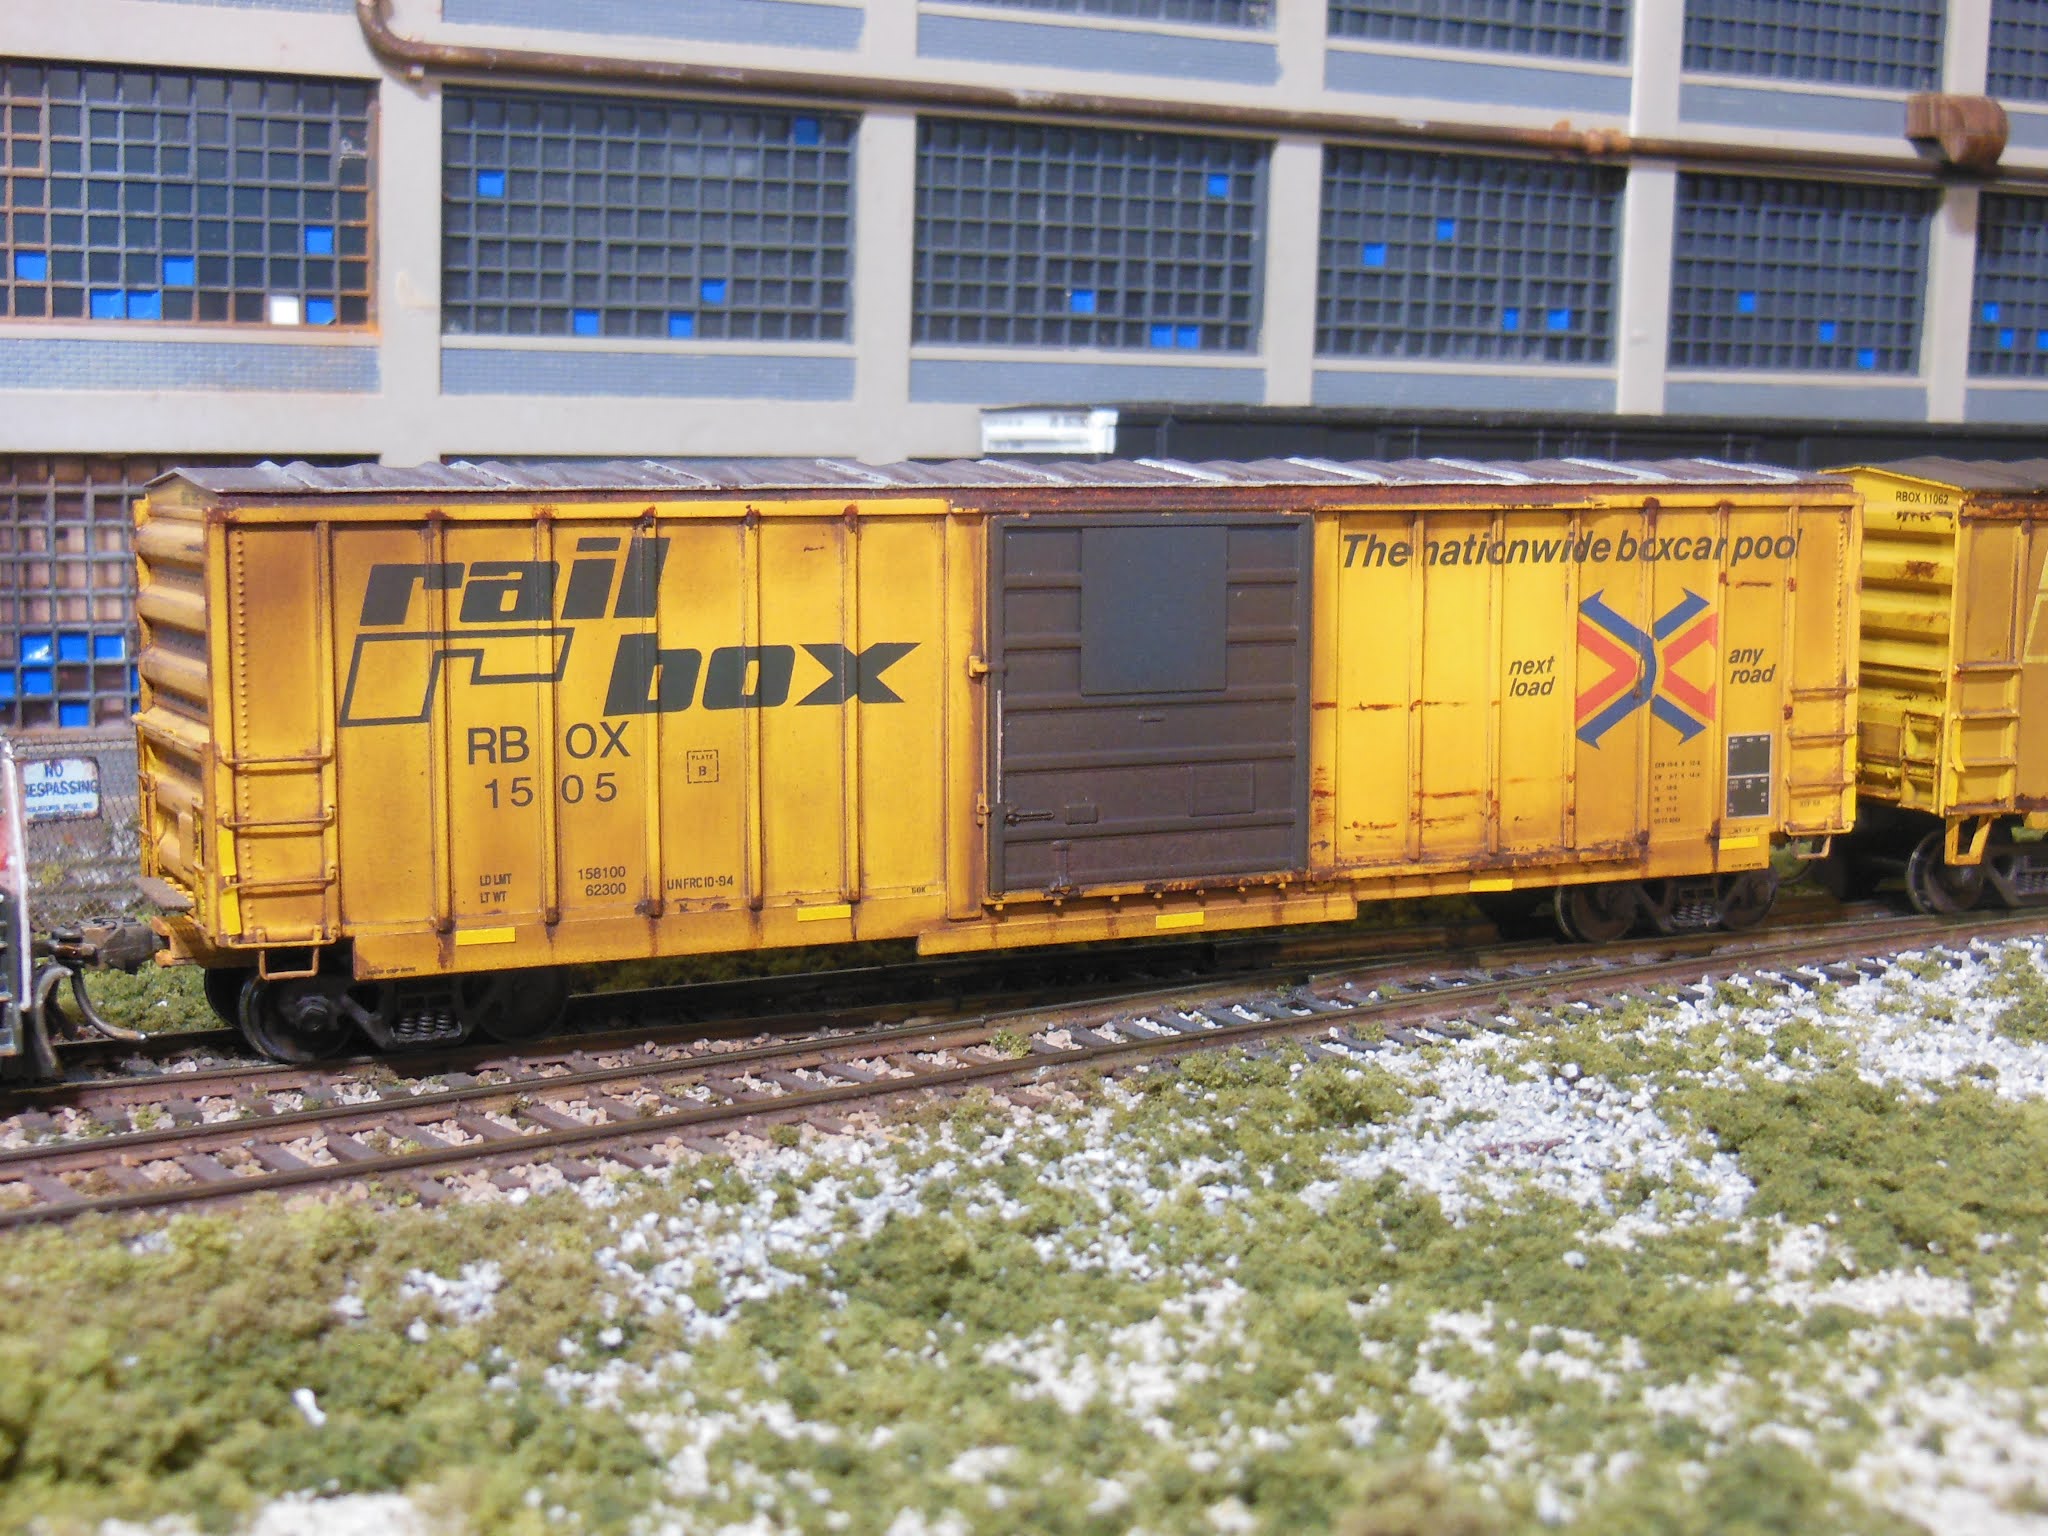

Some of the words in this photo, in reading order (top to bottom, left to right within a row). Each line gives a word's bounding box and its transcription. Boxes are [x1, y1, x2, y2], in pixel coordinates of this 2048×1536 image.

[1895, 490, 1921, 504] RBOX
[1923, 492, 1949, 505] 11062
[1341, 533, 1411, 569] The
[1420, 530, 1611, 566] nationwide
[1616, 529, 1726, 564] boxcar
[1730, 528, 1803, 568] pool
[359, 537, 671, 627] rail
[1507, 655, 1555, 676] next
[1728, 646, 1764, 666] any
[602, 632, 922, 718] box
[1729, 664, 1776, 686] road
[1508, 676, 1555, 698] load
[43, 761, 64, 778] NO
[479, 874, 492, 887] LD
[578, 865, 626, 880] 158100
[585, 882, 627, 897] 62300
